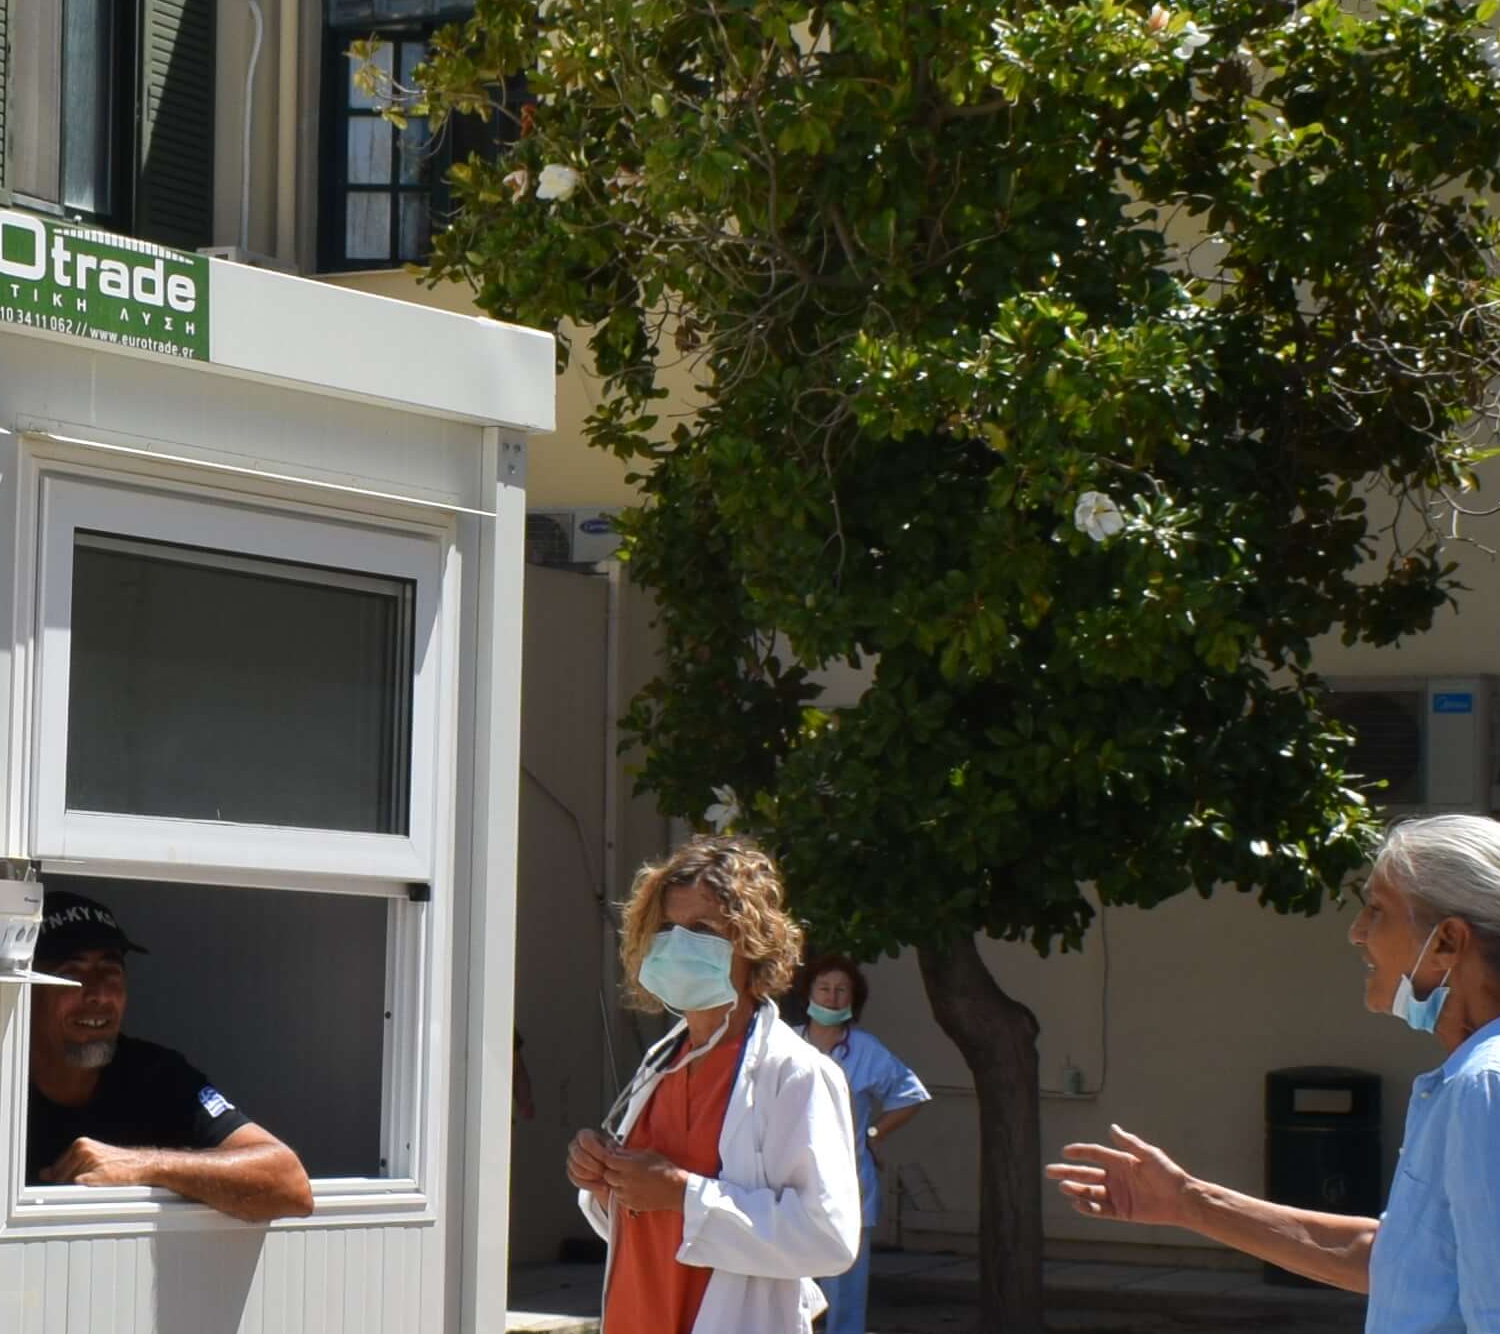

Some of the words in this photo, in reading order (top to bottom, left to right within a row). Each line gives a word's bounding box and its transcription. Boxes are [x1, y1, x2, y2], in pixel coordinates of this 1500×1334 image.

[16, 308, 32, 324] 34
[36, 313, 47, 329] 11
[50, 317, 73, 334] 062
[89, 326, 195, 359] www.eurotrade.gr
[119, 307, 196, 336] ΛΥΣΗ
